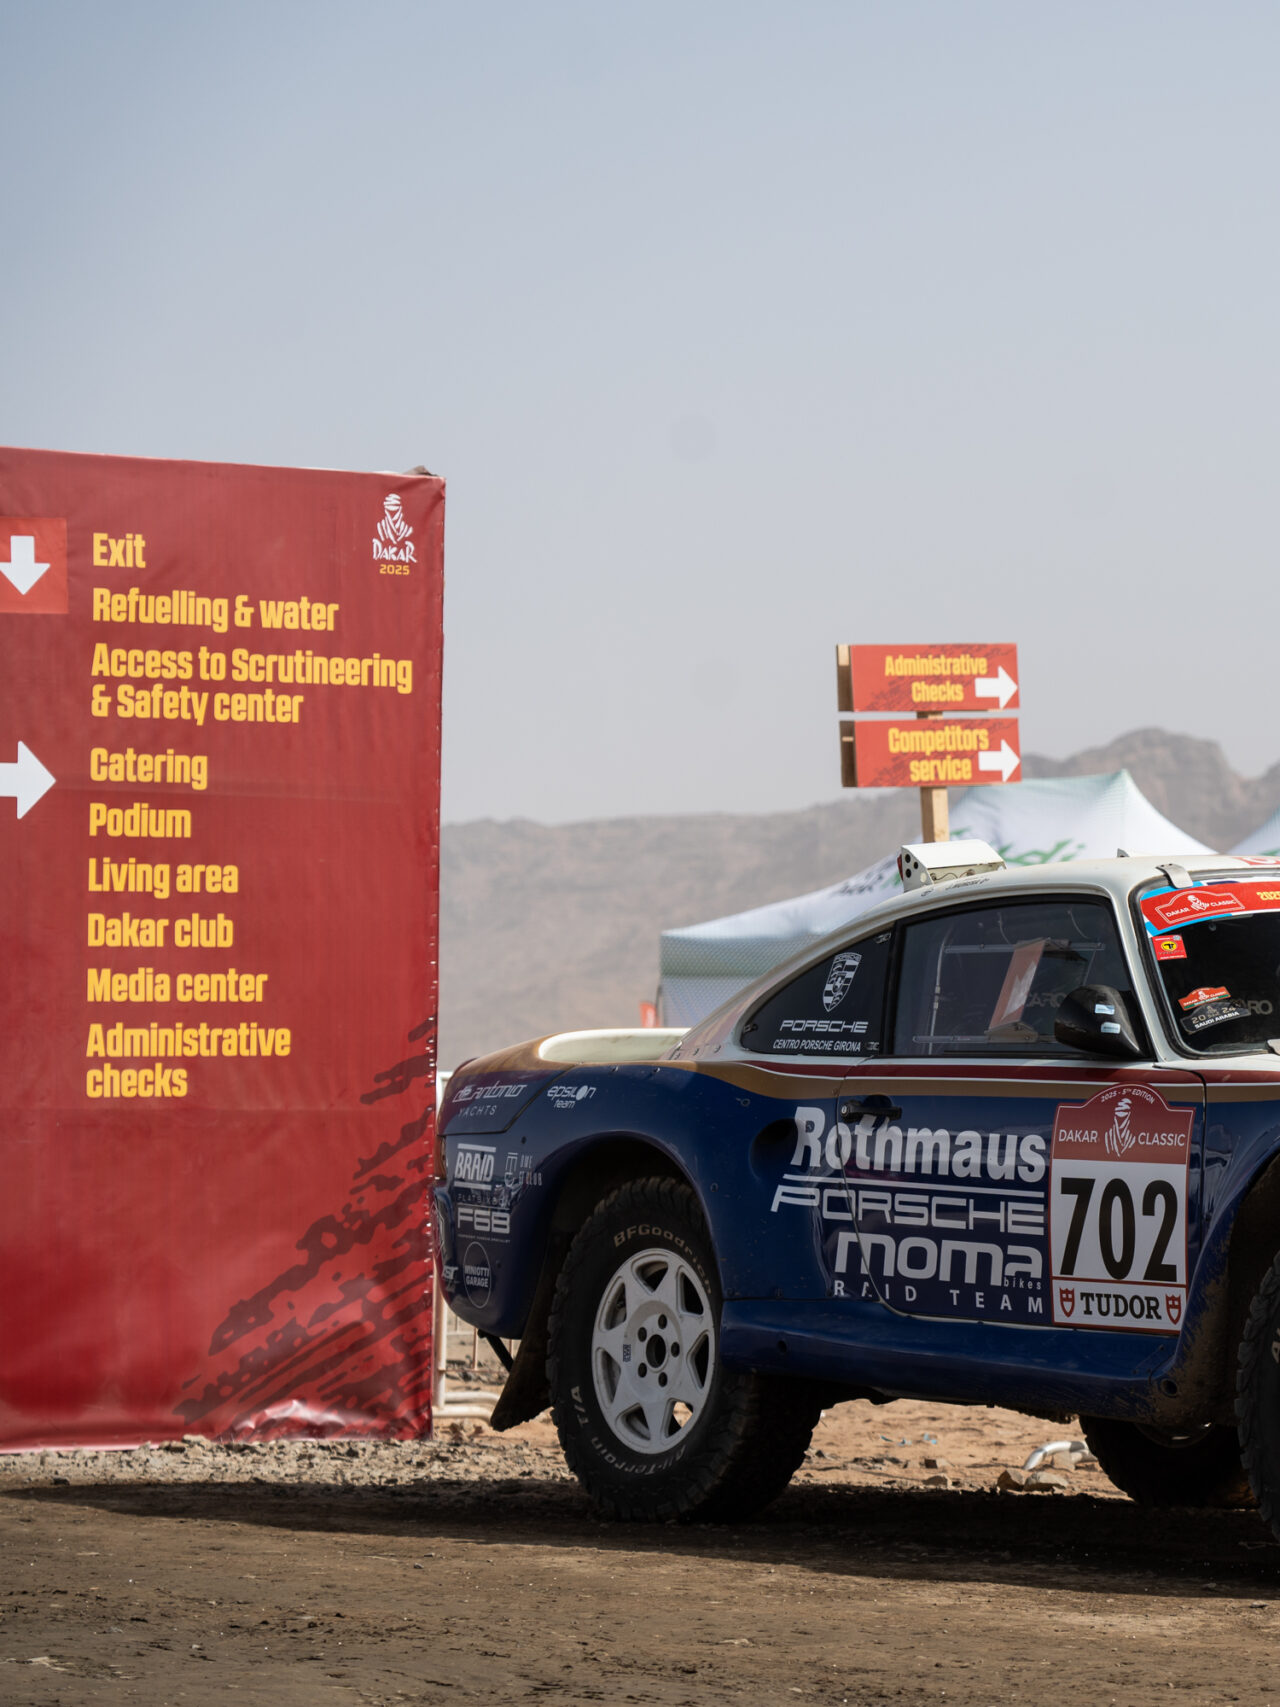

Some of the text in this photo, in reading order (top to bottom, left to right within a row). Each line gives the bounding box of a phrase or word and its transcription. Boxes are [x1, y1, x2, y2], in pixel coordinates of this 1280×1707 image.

[92, 532, 146, 569] Exit
[372, 538, 417, 564] DAKAR
[379, 564, 411, 576] 2025
[92, 587, 339, 633] Refuelling & water
[91, 643, 413, 695] Access to Scrutineering
[885, 654, 988, 676] Administrative
[91, 683, 304, 726] & Safety center
[911, 681, 964, 702] Checks
[888, 725, 990, 756] Competitors
[89, 747, 208, 791] Catering
[909, 755, 972, 782] service
[88, 803, 192, 838] Podium
[88, 857, 239, 900] Living area
[1165, 899, 1237, 917] DAKAR CLASSIC
[87, 912, 234, 948] Dakar club
[87, 967, 268, 1002] Media center
[779, 1020, 869, 1033] PORSCHE
[1194, 1018, 1215, 1029] SAUDI
[1215, 1011, 1240, 1022] ARABIA
[86, 1022, 291, 1058] Administrative
[773, 1039, 861, 1052] CENTRO PORSCHE GIRONA
[86, 1062, 188, 1098] checks
[458, 1105, 497, 1118] YACHTS
[553, 1099, 577, 1110] team
[1058, 1129, 1186, 1147] DAKAR CLASSIC
[455, 1151, 495, 1182] BRAID
[770, 1184, 1044, 1236] PORSCHE
[1060, 1177, 1178, 1282] 702
[834, 1231, 1043, 1287] moma
[466, 1275, 489, 1288] GARAGE
[833, 1280, 1043, 1314] RAID TEAM
[1003, 1277, 1042, 1290] bikes
[1080, 1291, 1162, 1320] TUDOR
